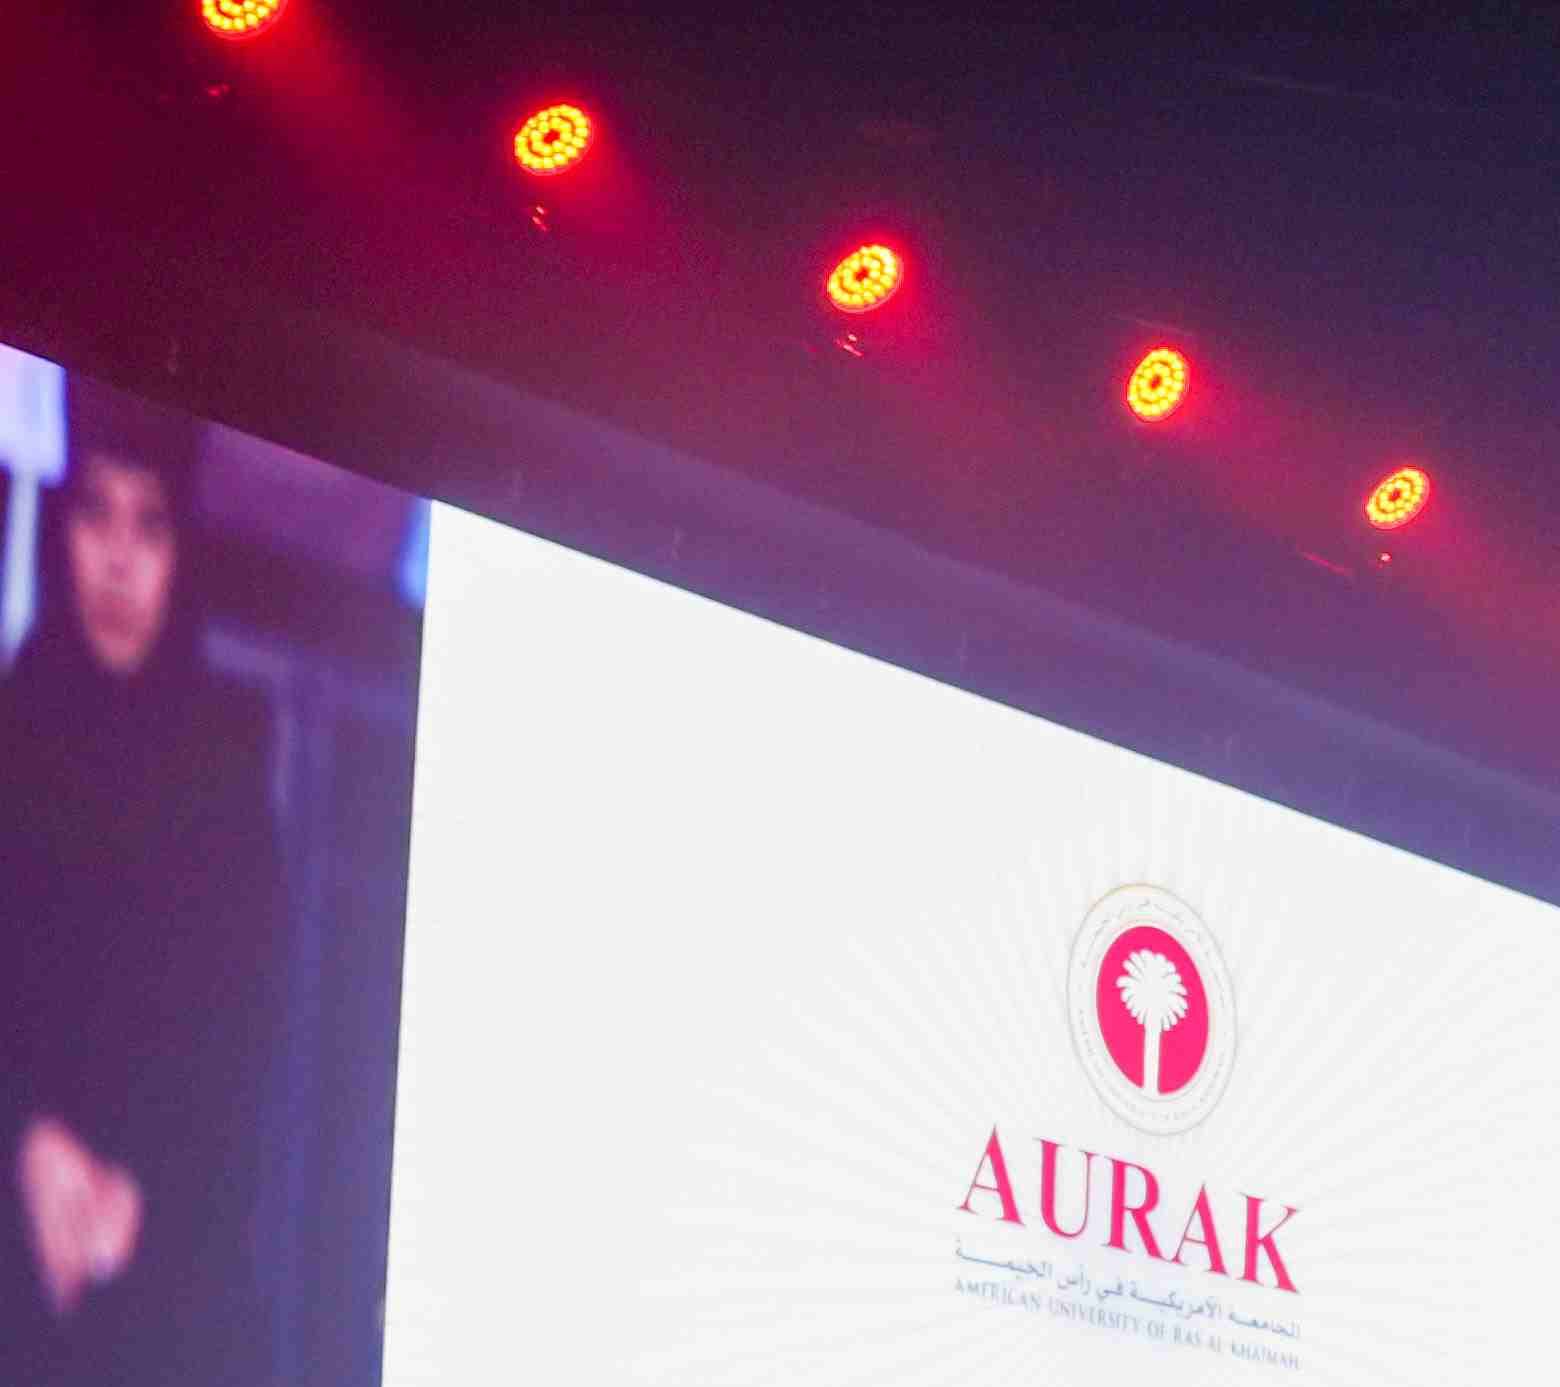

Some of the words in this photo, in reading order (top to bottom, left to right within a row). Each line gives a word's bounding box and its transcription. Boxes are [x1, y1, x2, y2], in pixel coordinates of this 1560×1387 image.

[956, 1124, 1300, 1294] AURAK
[954, 1278, 1041, 1311] AMERICAN
[1049, 1299, 1140, 1334] UNIVERSITY
[1147, 1320, 1166, 1338] OF
[1173, 1326, 1201, 1346] RAS
[1231, 1340, 1300, 1370] KHAIMAH
